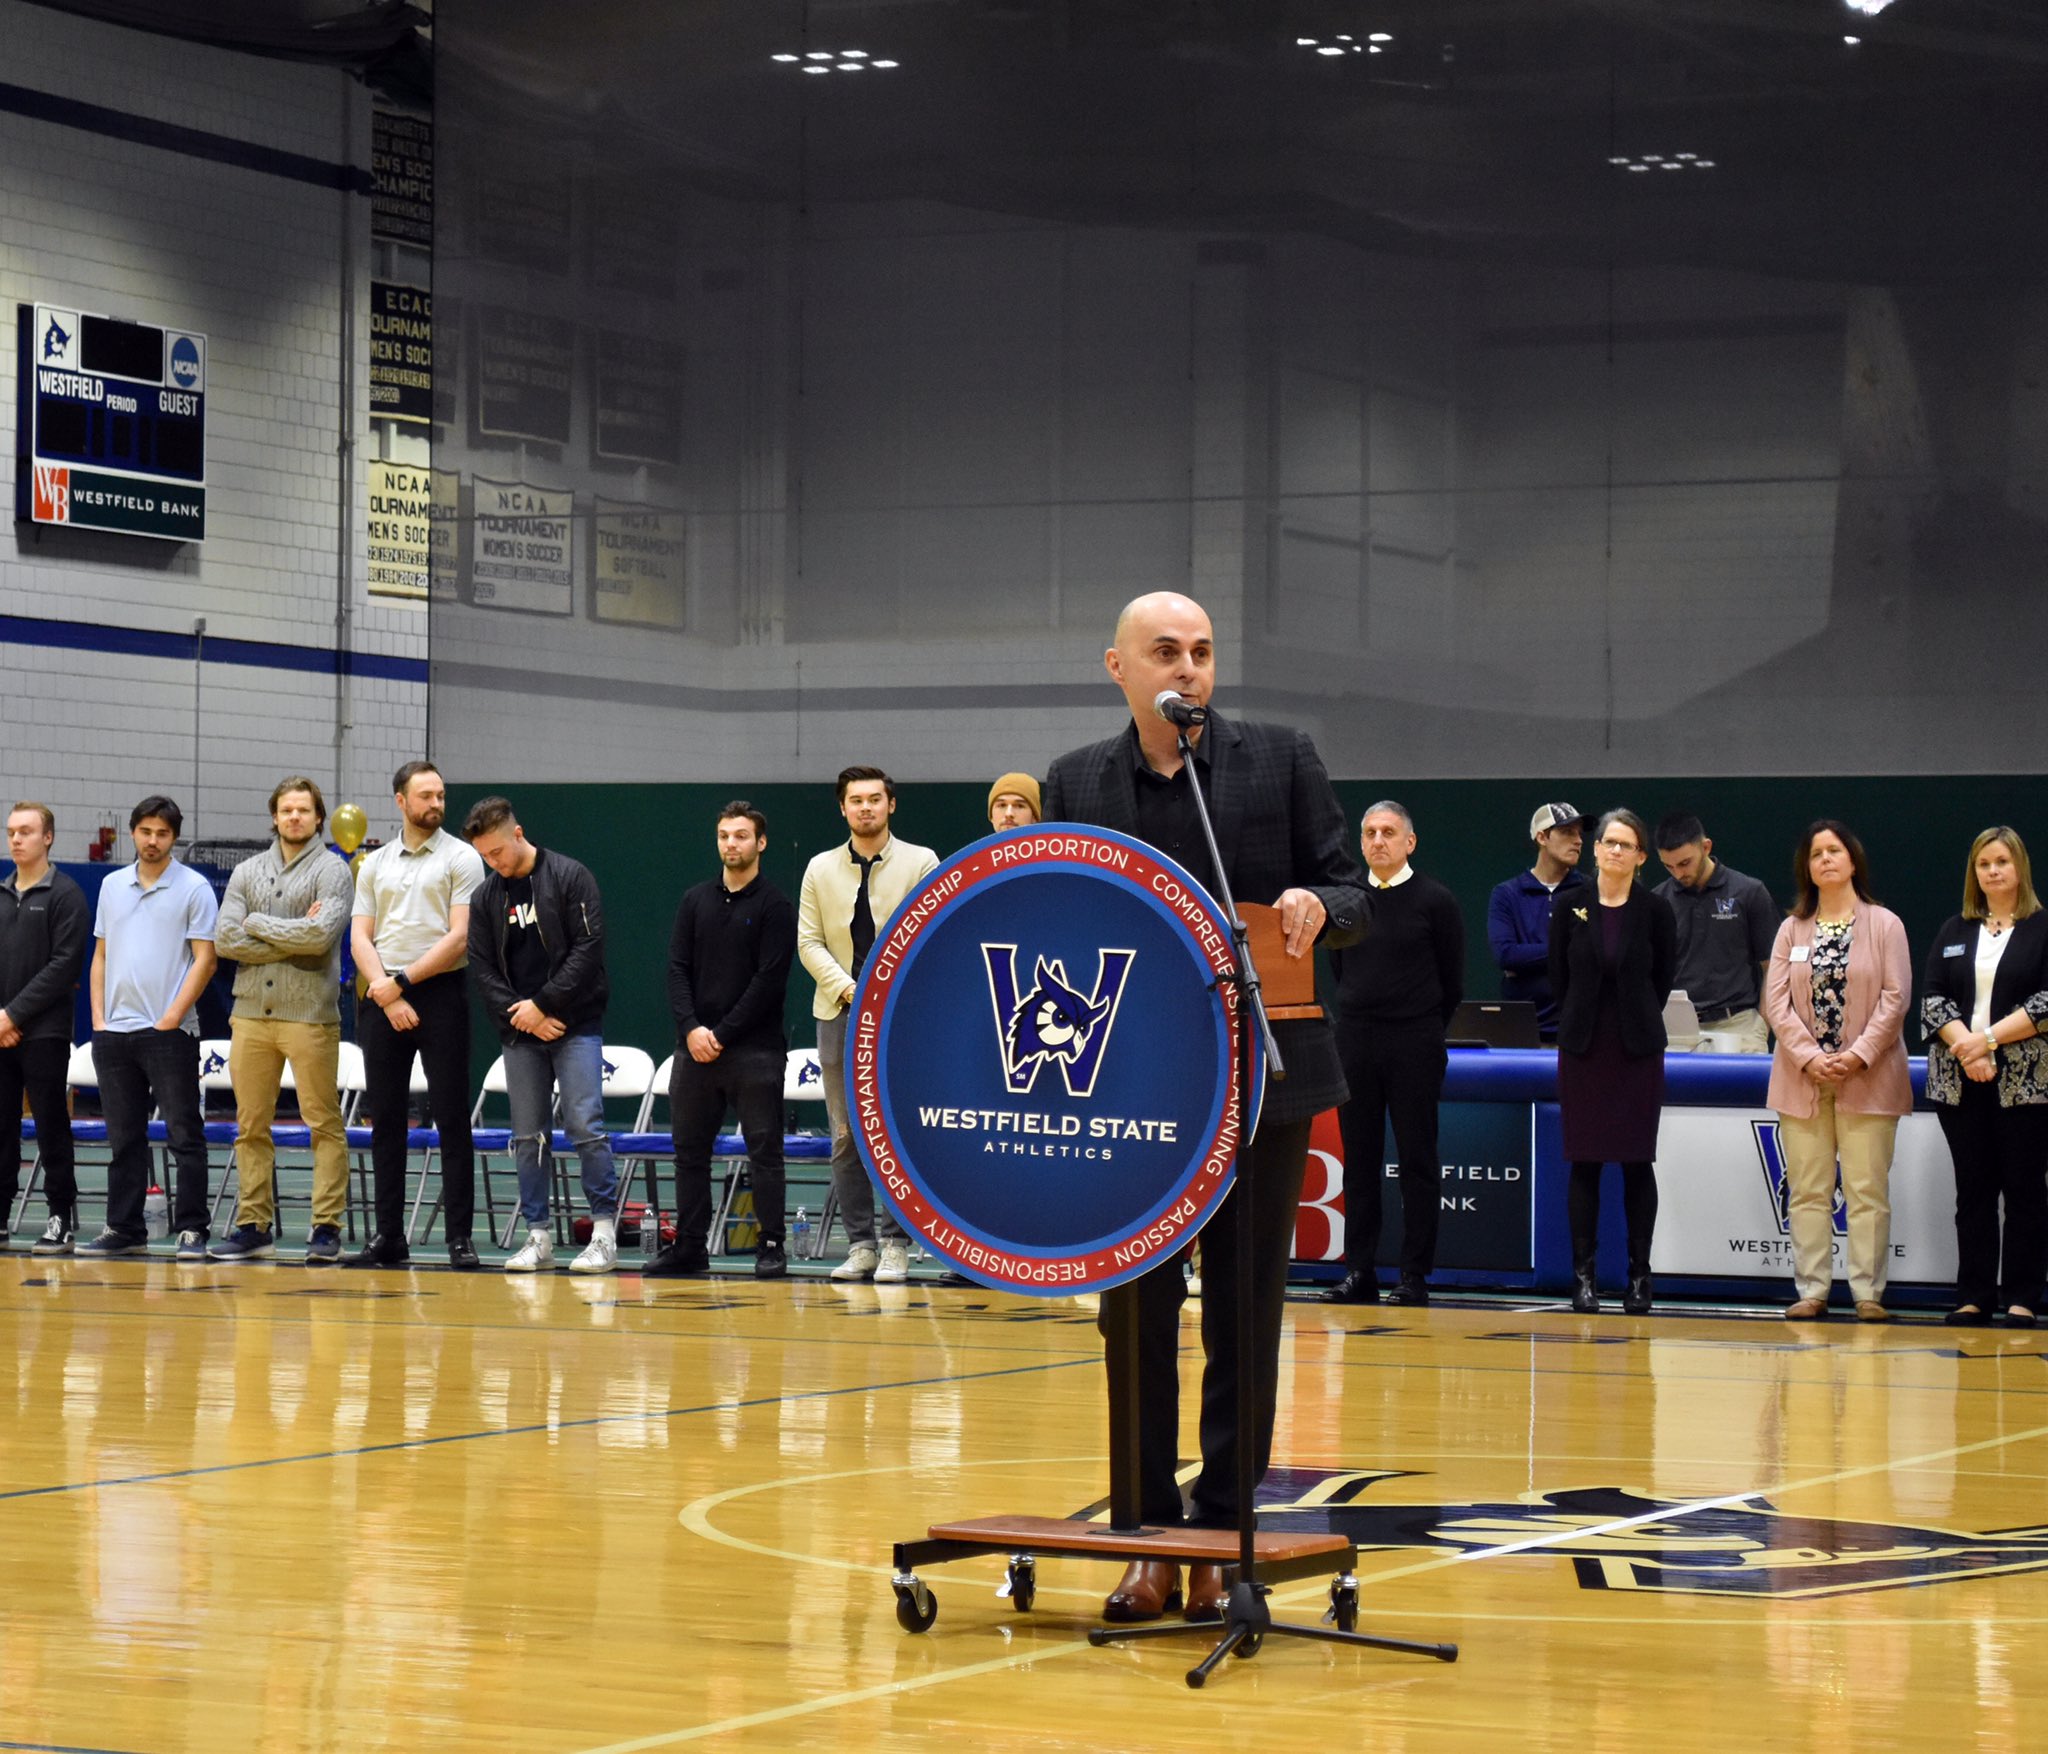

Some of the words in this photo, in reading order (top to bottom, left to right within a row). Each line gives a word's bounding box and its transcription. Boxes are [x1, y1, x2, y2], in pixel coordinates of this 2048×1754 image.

[372, 153, 400, 173] EN'S
[406, 160, 431, 179] SOC
[371, 313, 430, 340] OURNAM
[406, 344, 431, 366] SOC
[173, 360, 198, 378] NCAA
[39, 371, 103, 401] WESTFIELD
[106, 394, 137, 413] PERIOD
[159, 391, 198, 416] GUEST
[385, 472, 430, 495] NCAA
[74, 489, 155, 512] WESTFIELD
[161, 497, 199, 518] BANK
[370, 496, 456, 521] OURNAMENT
[498, 491, 549, 515] NCAA
[478, 513, 567, 541] TOURNAMENT
[483, 537, 523, 559] WOMEN'S
[526, 542, 563, 564] SOCCER
[990, 838, 1130, 869] PROPORTION
[875, 870, 964, 982] CITIZENSHIP
[857, 1011, 912, 1202] SPORTSMANSHIP
[919, 1107, 1081, 1137] WESTFIELD
[1089, 1117, 1178, 1143] STATE
[984, 1143, 1113, 1161] ATHLETICS
[1440, 1196, 1477, 1212] NK
[1114, 1197, 1197, 1264] PASSION
[922, 1217, 1087, 1283] RESPONSIBILITY
